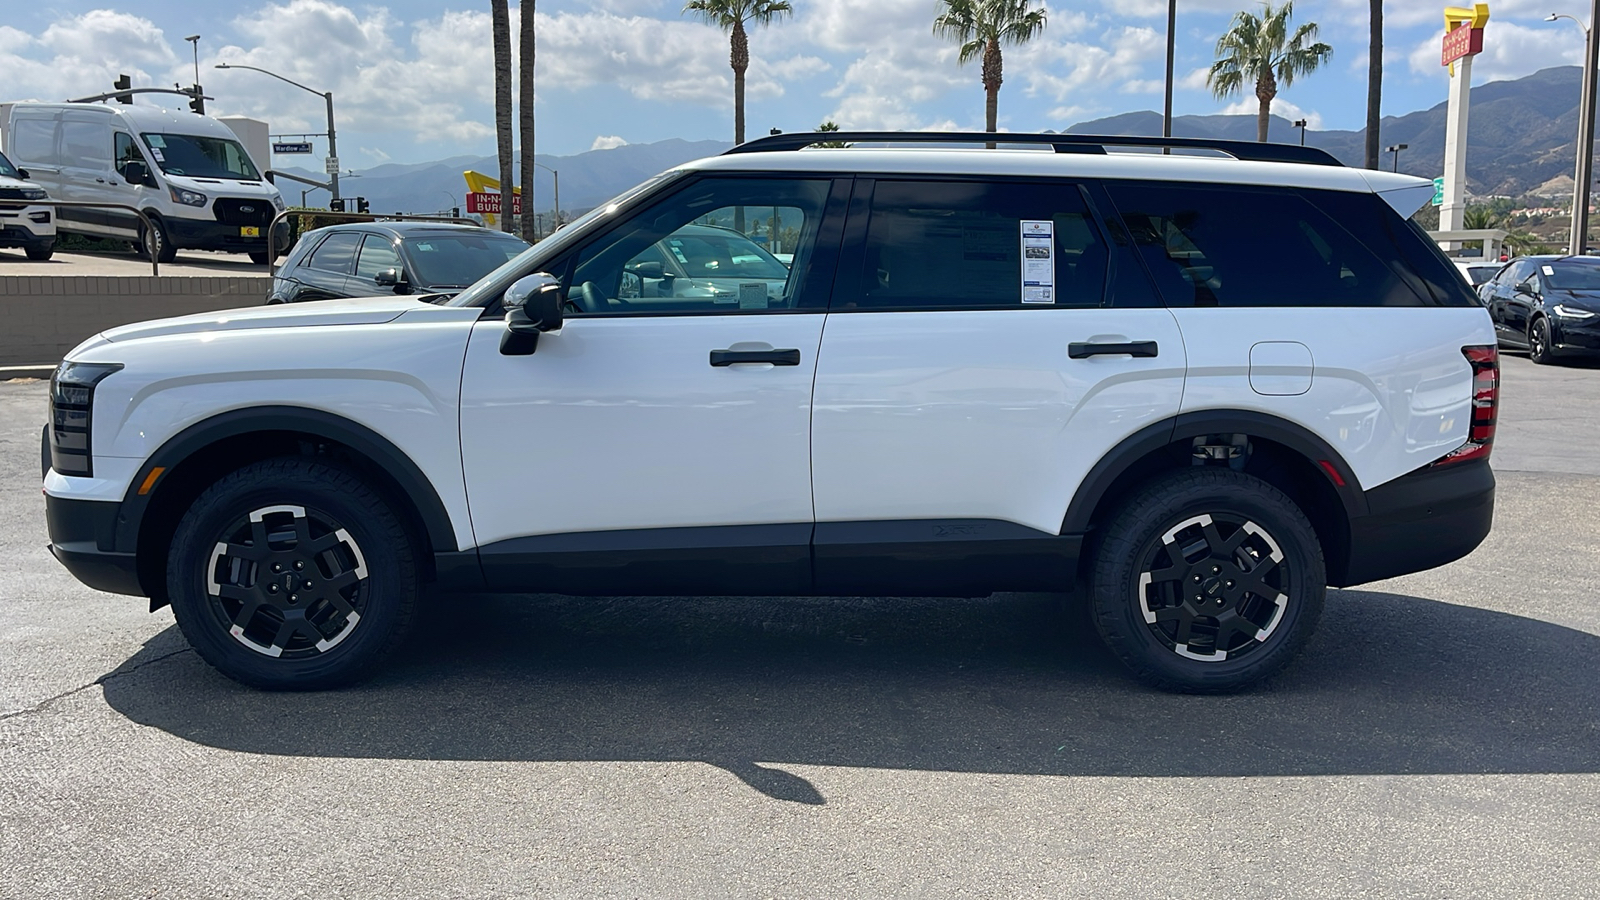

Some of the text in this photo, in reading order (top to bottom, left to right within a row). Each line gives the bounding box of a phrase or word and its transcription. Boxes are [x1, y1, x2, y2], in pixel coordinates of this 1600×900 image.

[1443, 25, 1470, 49] IN-N-OUT
[1443, 39, 1469, 62] BURGER
[476, 194, 521, 204] IN-N-T
[477, 203, 520, 213] BURR
